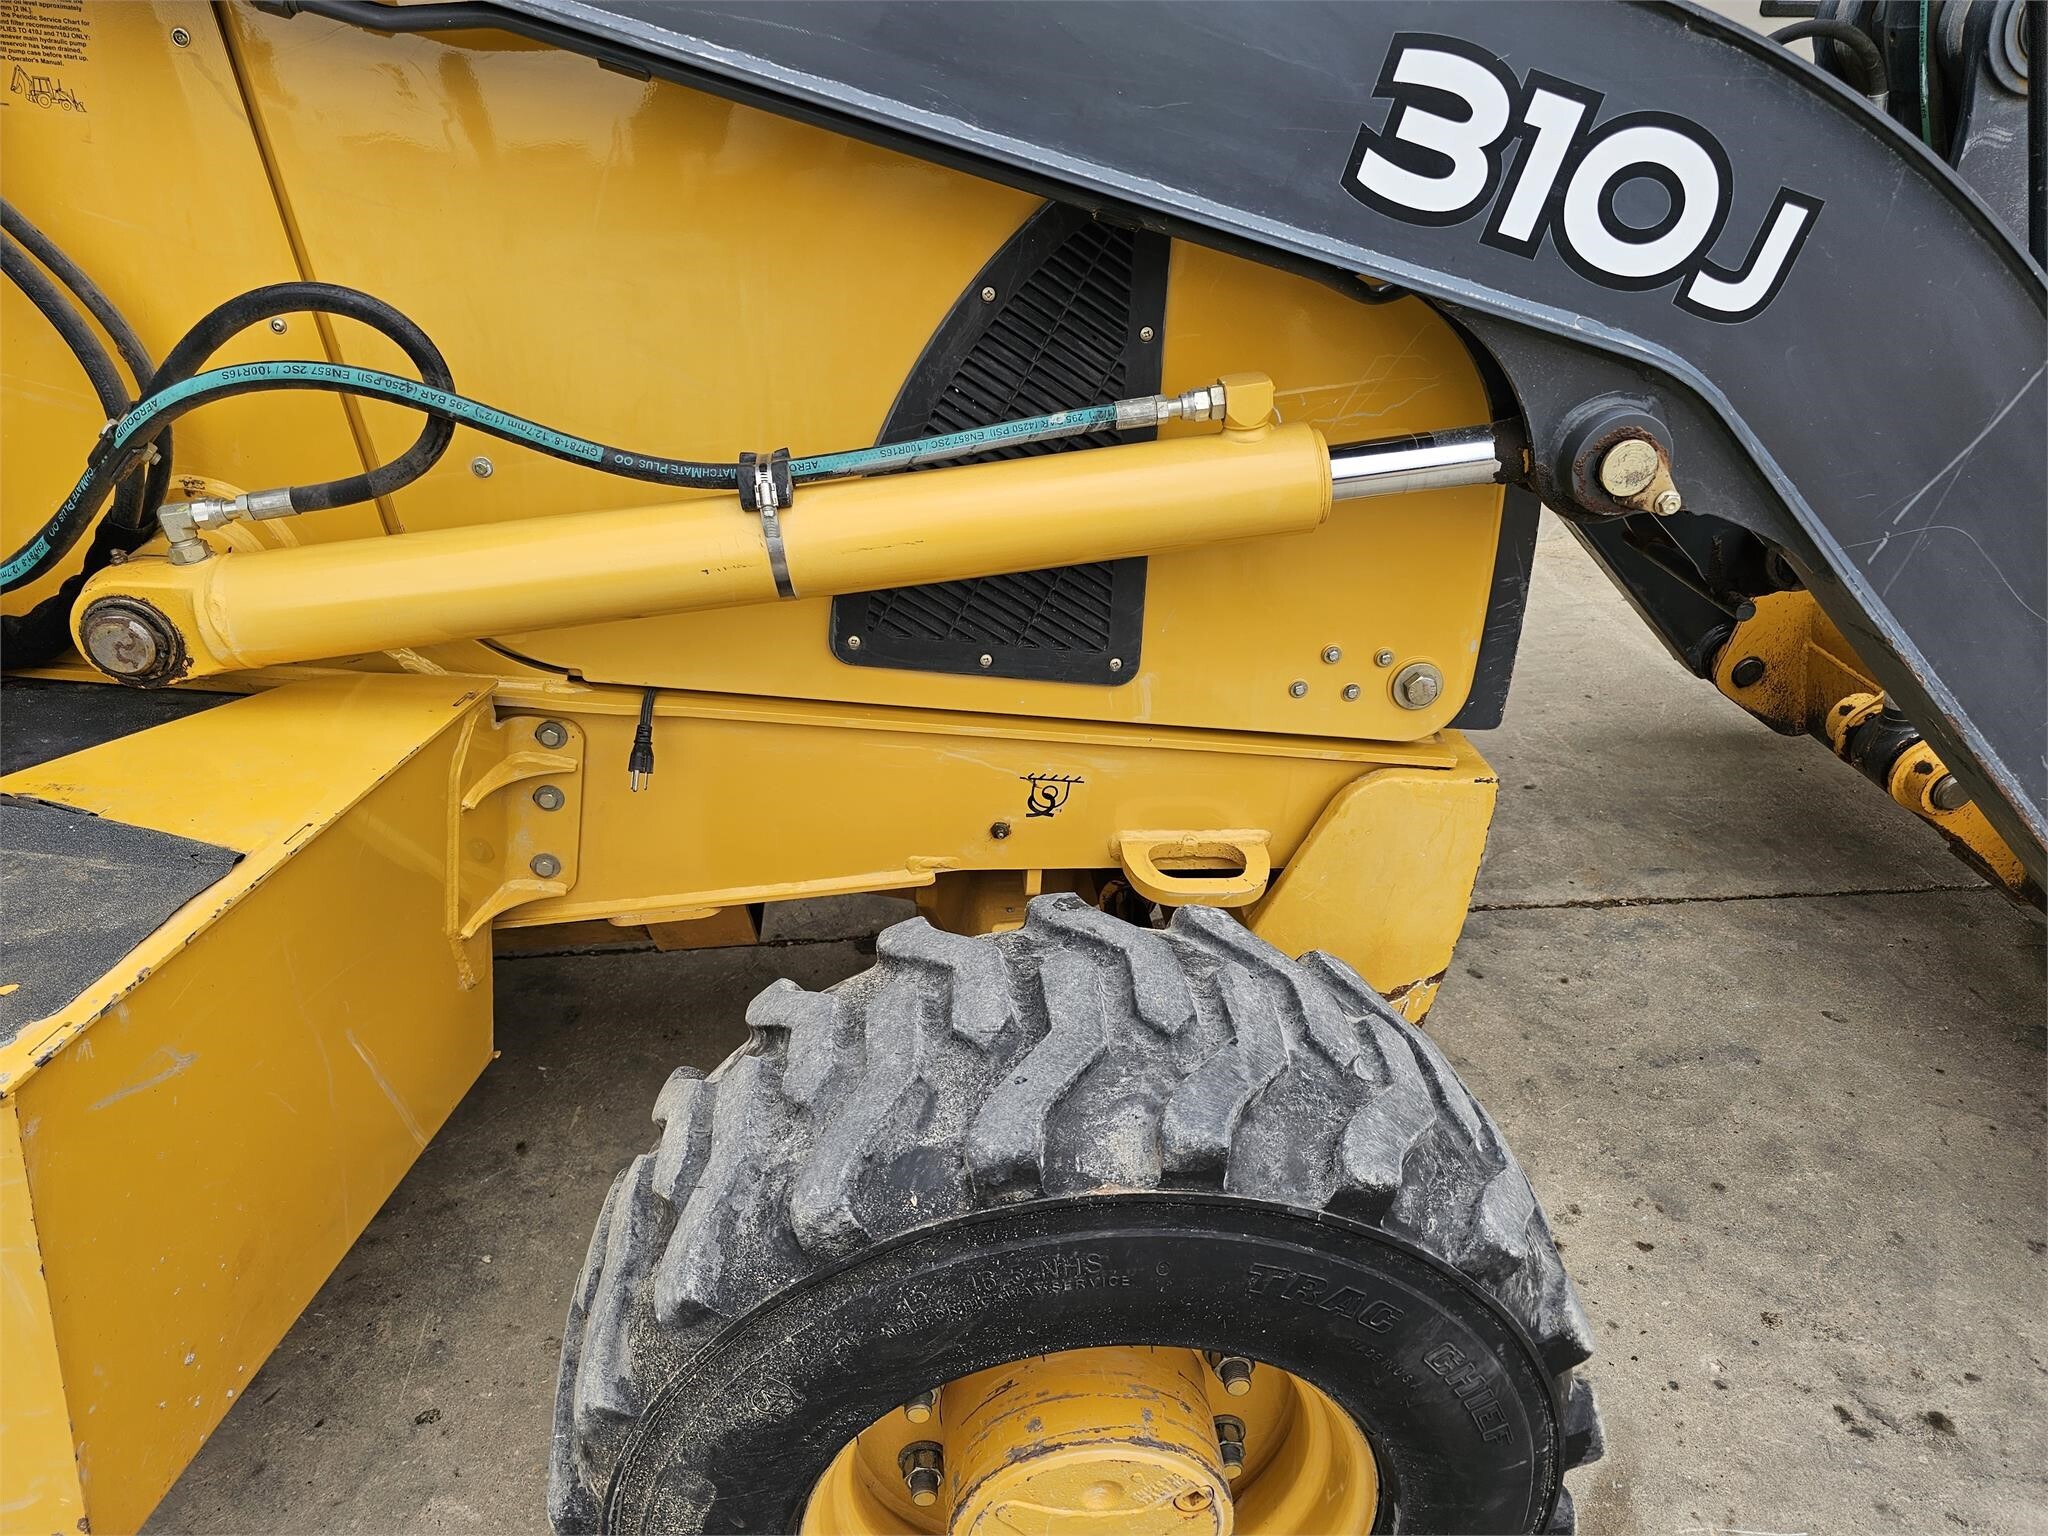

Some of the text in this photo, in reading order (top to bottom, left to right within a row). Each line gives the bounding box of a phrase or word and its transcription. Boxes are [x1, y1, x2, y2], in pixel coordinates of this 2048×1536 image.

[39, 2, 82, 12] approximately
[12, 12, 38, 21] Periodic
[39, 15, 62, 25] Service
[63, 17, 80, 26] Chart
[26, 22, 82, 33] recommendations.
[28, 28, 42, 36] 410J
[40, 36, 68, 45] hydraulic
[41, 43, 56, 51] been
[7, 54, 40, 63] Operator's
[40, 58, 65, 67] Manual.
[8, 48, 26, 56] pump
[42, 50, 63, 59] before
[1348, 40, 1816, 318] 310J
[221, 365, 272, 380] 100R16S
[283, 365, 307, 375] 2SC
[311, 366, 350, 380] EN857
[420, 391, 447, 405] BAR
[448, 401, 470, 413] 295
[116, 398, 158, 439] AEROQUIP
[1064, 413, 1084, 424] 295
[989, 426, 1010, 438] PSI)
[1012, 419, 1039, 433] (4250
[931, 437, 951, 449] 2SC
[953, 430, 985, 445] EN857
[555, 437, 598, 457] GH781-8
[880, 442, 922, 458] 100R16S
[638, 459, 668, 474] PLUS
[58, 498, 76, 523] PLUS
[1040, 1251, 1103, 1279] NHS
[1051, 1274, 1131, 1294] SERVICE
[1249, 1262, 1514, 1446] TRAC CHIEF
